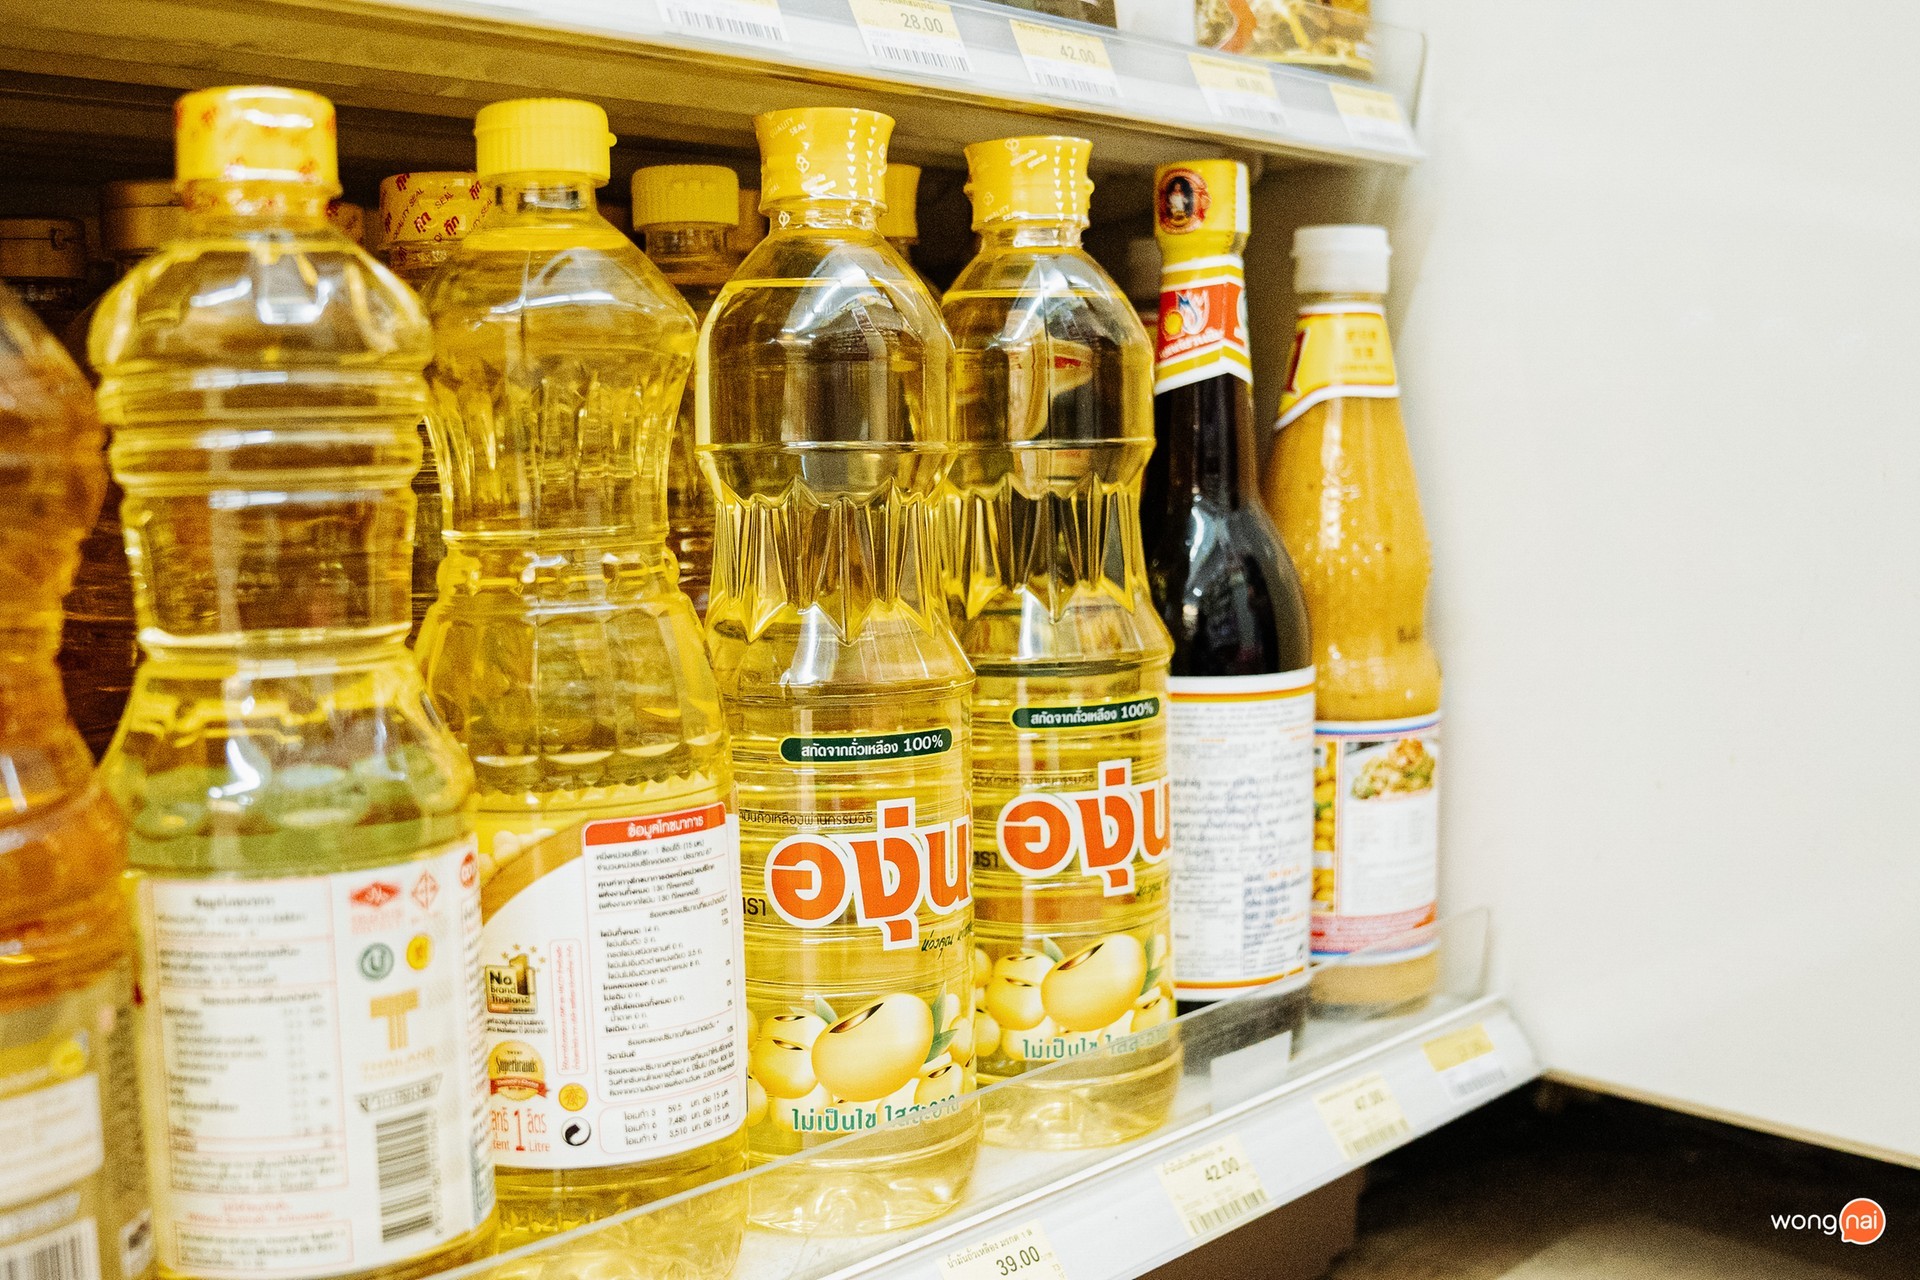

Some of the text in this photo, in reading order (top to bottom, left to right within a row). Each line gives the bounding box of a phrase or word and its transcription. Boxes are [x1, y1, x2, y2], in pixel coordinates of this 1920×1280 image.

[900, 12, 943, 34] 28.00
[1060, 44, 1096, 65] 42.00
[434, 191, 454, 209] SEAL
[1030, 702, 1154, 726] สกัดจากถั่วเหลือง 100%
[800, 733, 943, 757] สกัดจากถั่วเหลือง 100%
[997, 759, 1170, 897] องุ่น
[766, 799, 972, 949] องุ่น
[742, 896, 766, 917] รา
[791, 1107, 877, 1132] ไม่เป็นไข
[1204, 1156, 1239, 1180] 42.00
[995, 1245, 1041, 1277] 39.00
